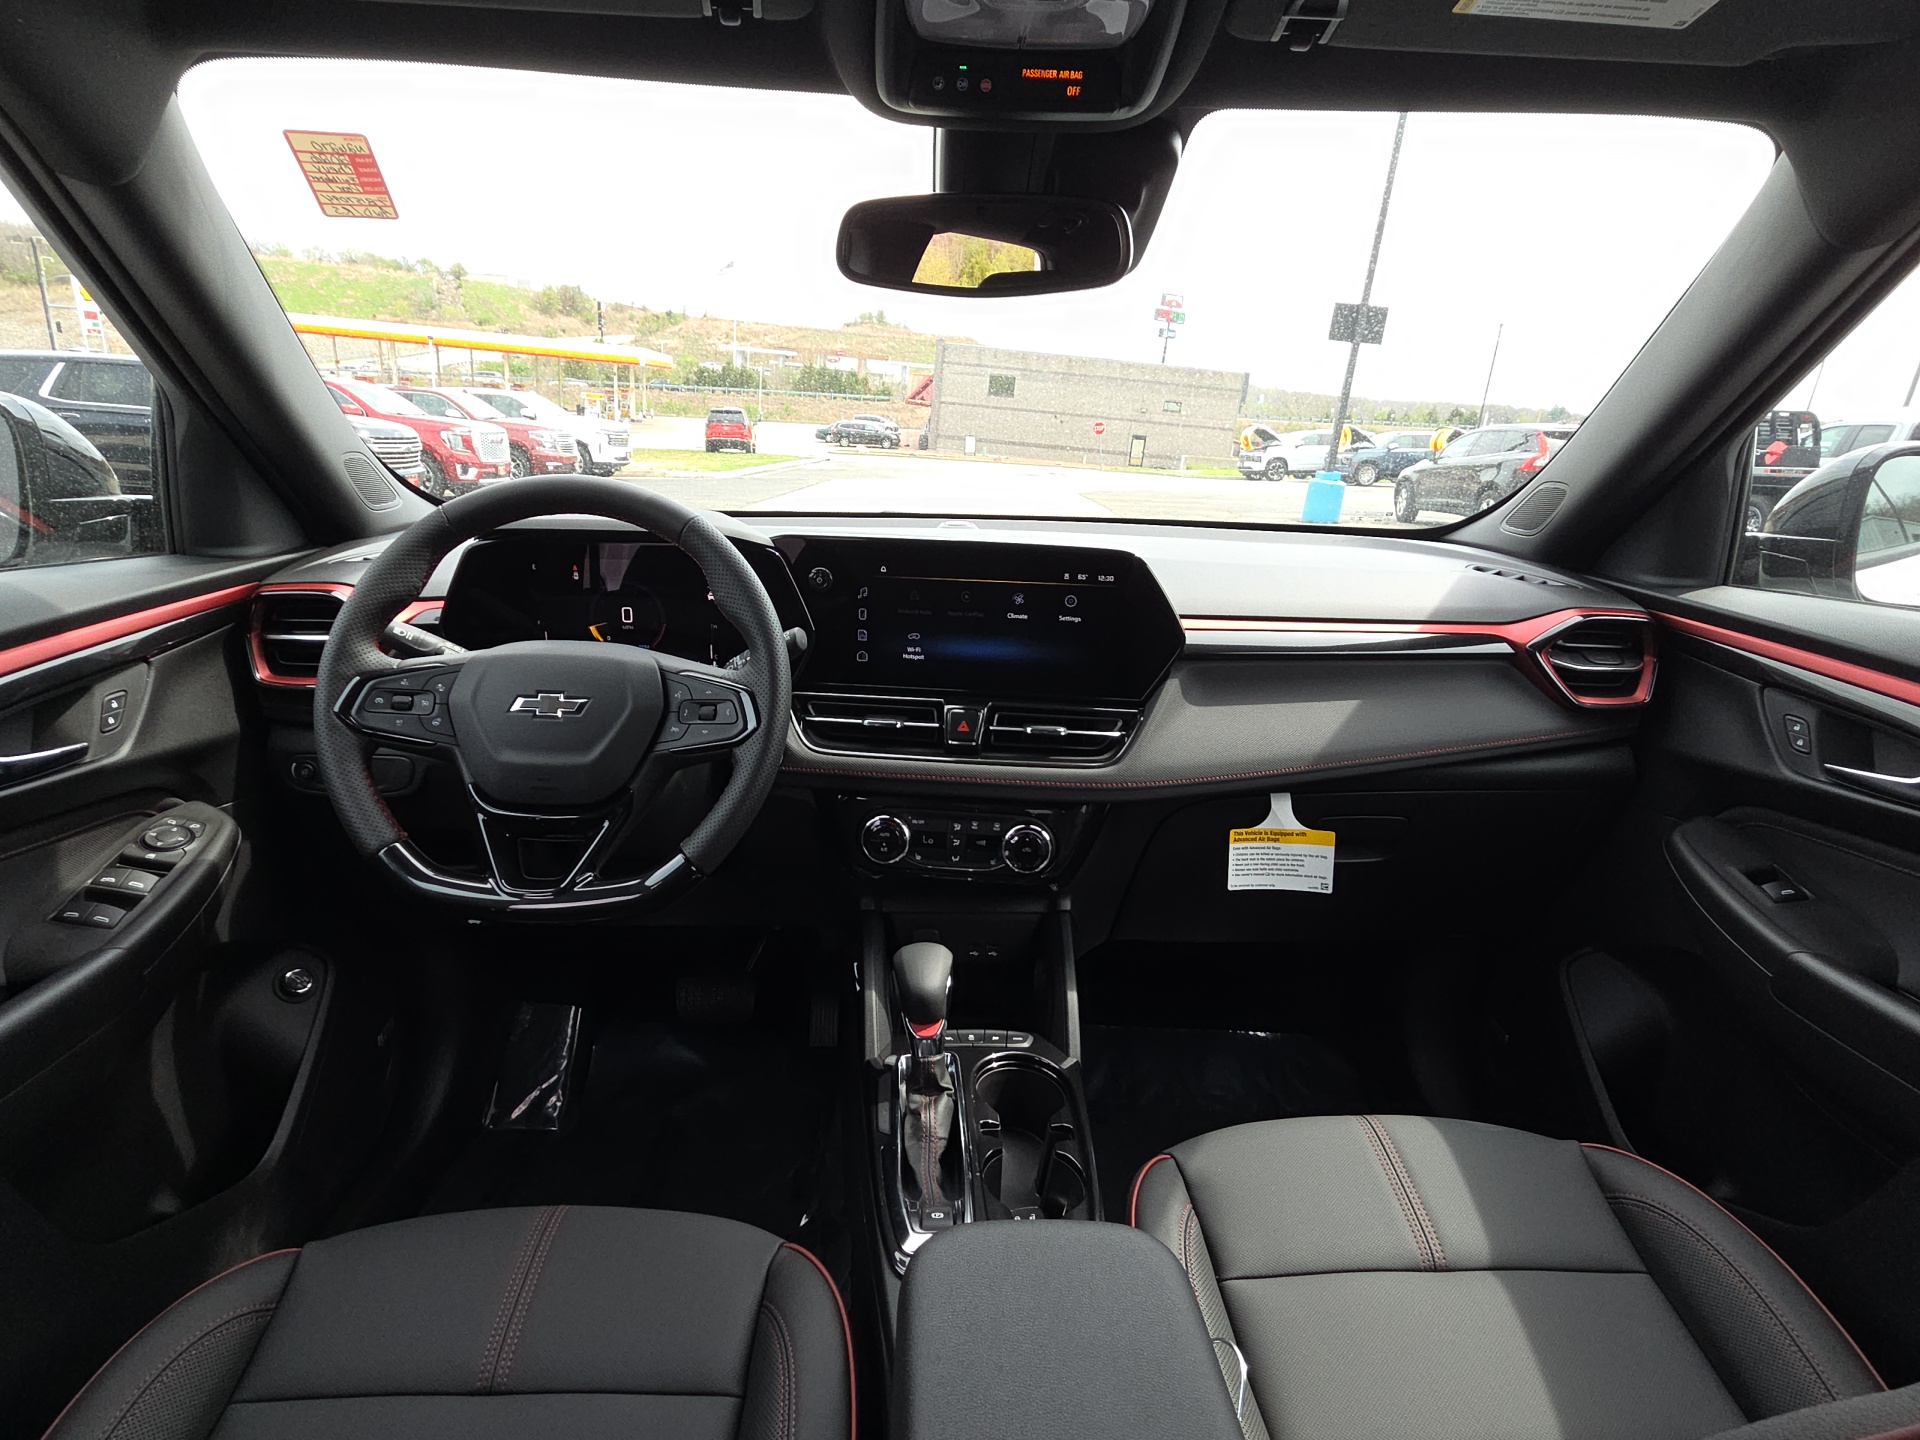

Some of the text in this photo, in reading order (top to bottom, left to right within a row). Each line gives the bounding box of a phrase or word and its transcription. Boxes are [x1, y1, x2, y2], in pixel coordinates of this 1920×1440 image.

[1021, 68, 1084, 80] PASSENGER AIR BAG
[1066, 85, 1082, 97] OFF
[621, 606, 634, 624] 0
[1058, 614, 1082, 623] Settings
